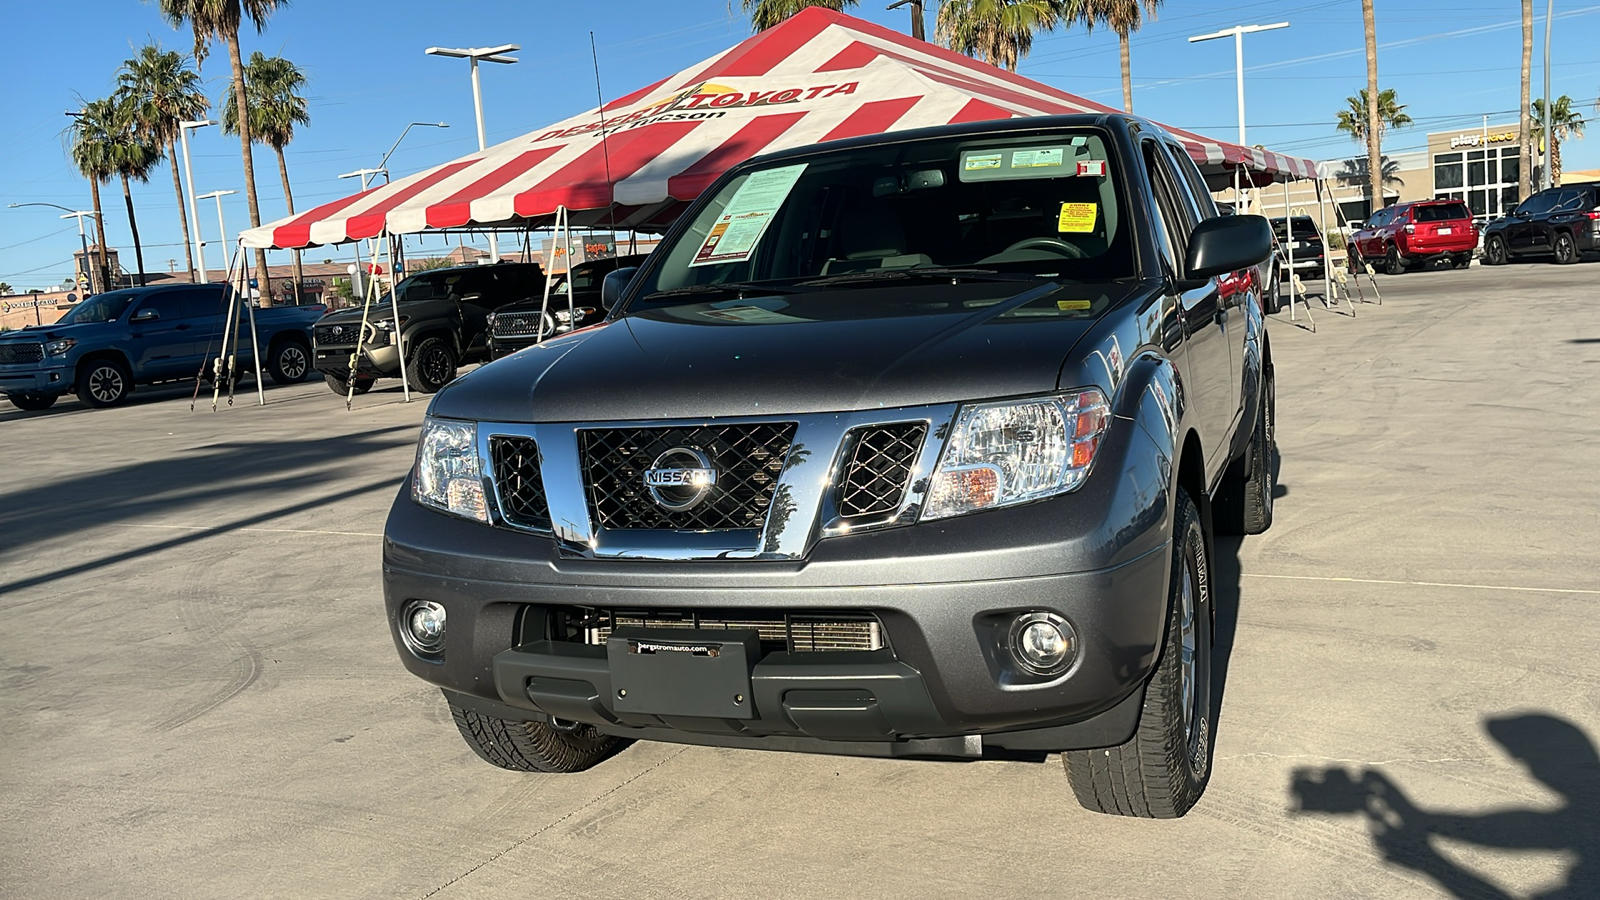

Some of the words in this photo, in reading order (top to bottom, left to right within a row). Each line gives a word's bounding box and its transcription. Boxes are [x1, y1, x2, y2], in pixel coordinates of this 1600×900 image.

[530, 101, 674, 143] DESERT
[684, 81, 860, 108] TOYOTA
[592, 124, 624, 137] of
[628, 111, 728, 129] Tucson
[648, 471, 706, 483] NISSAN
[637, 641, 708, 654] bergstromauto.com
